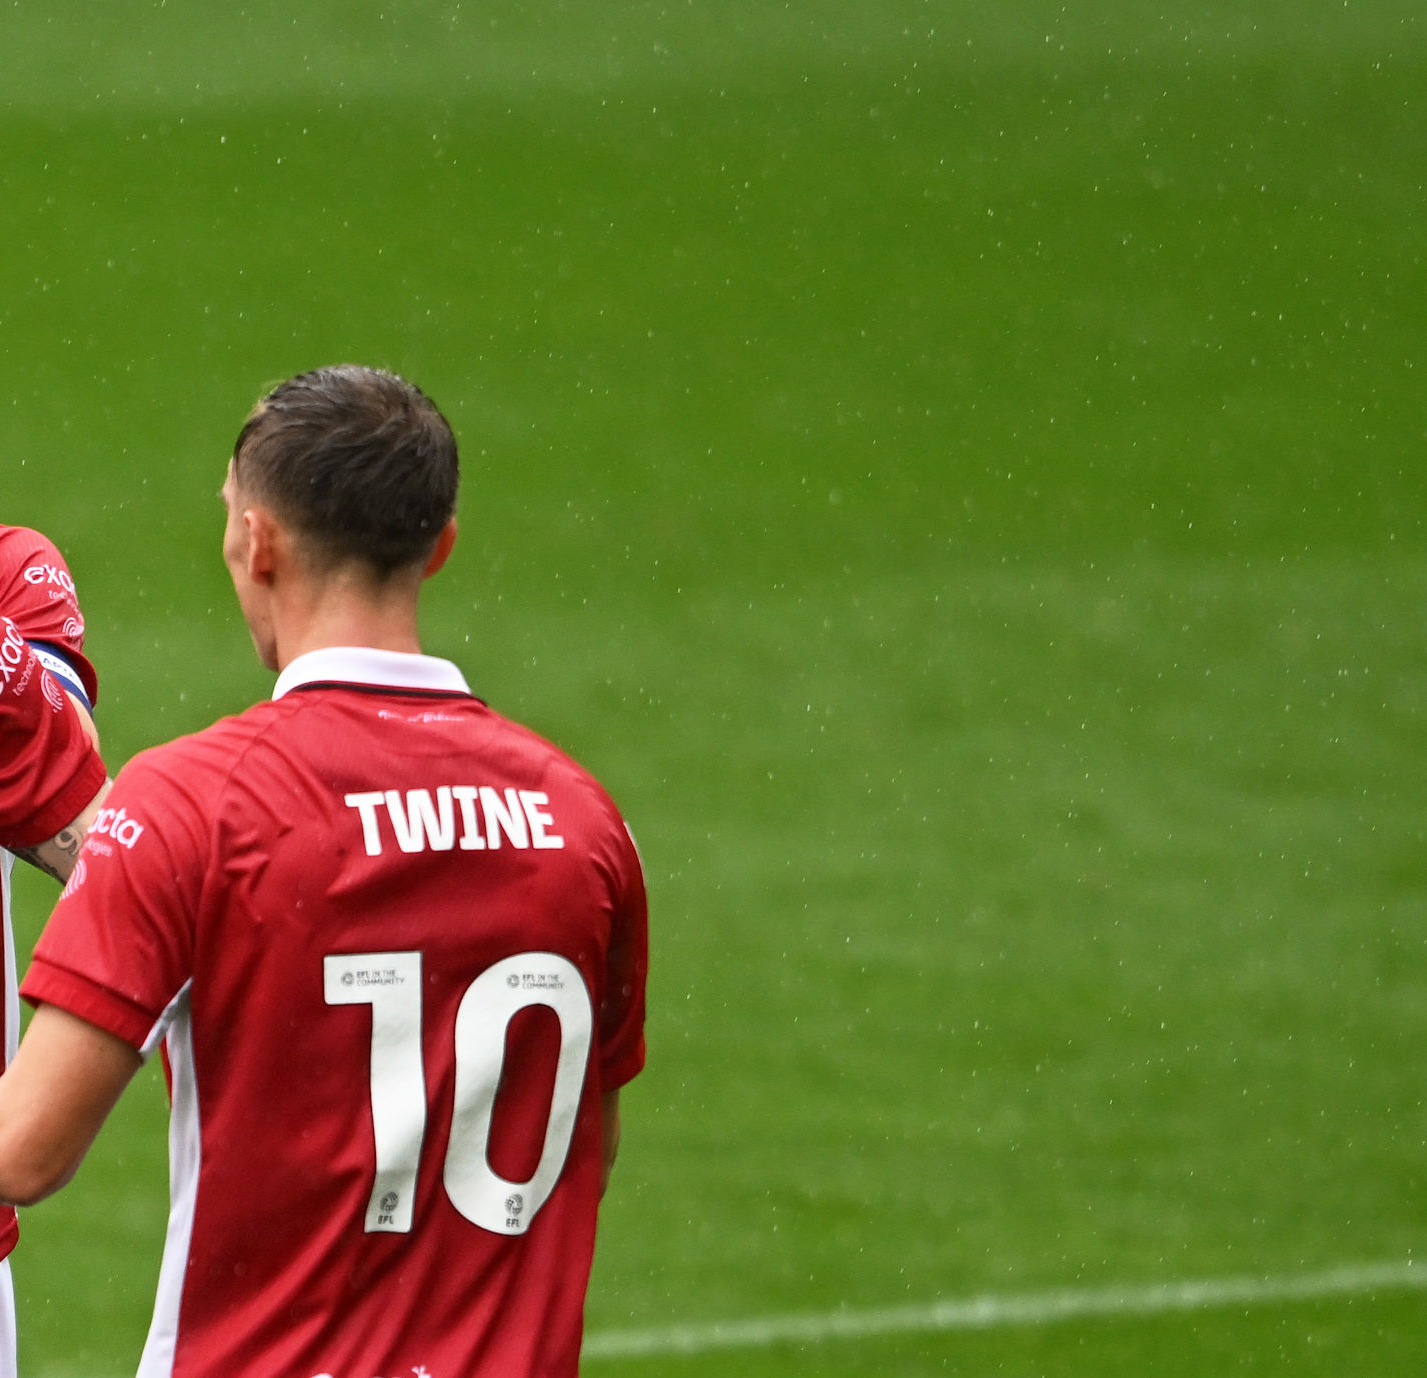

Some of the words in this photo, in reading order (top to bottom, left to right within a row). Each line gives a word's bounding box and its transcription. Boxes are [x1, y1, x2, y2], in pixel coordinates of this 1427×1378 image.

[345, 787, 563, 855] TWINE
[323, 951, 594, 1236] 10
[378, 1215, 394, 1225] EFL
[506, 1218, 520, 1228] EFL
